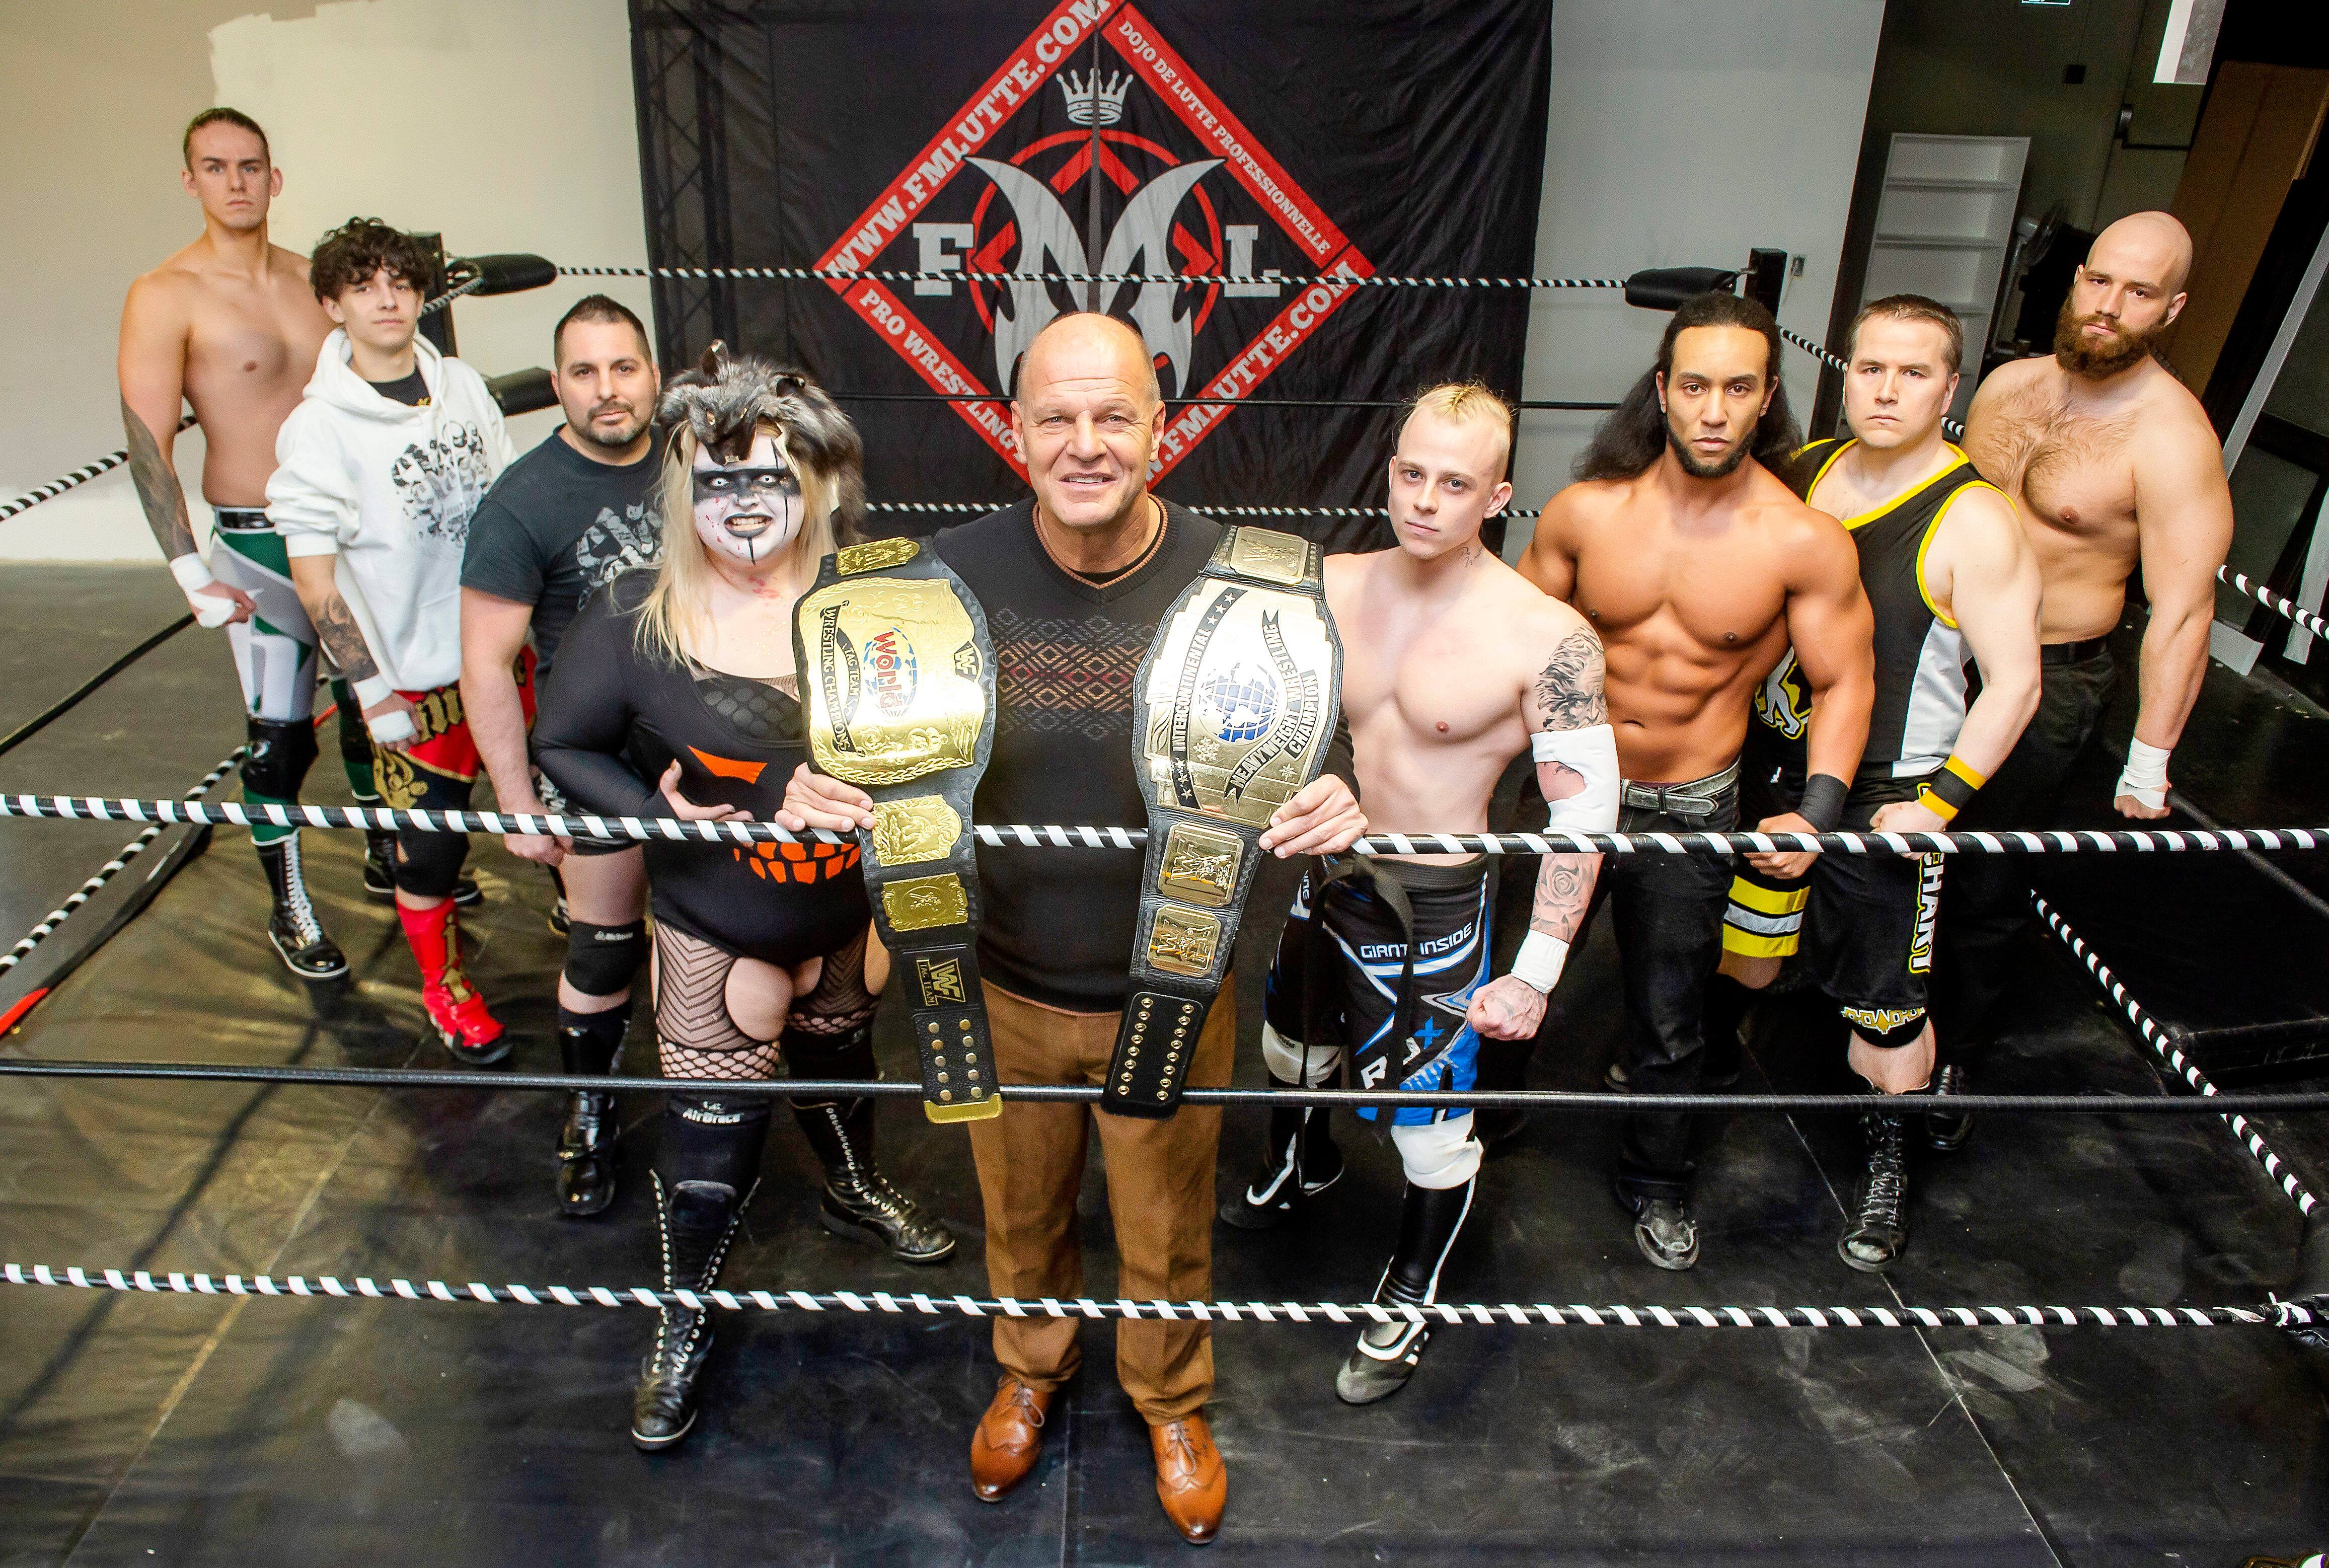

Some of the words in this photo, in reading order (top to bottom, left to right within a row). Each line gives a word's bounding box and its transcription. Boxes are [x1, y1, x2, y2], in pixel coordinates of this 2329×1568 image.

[824, 0, 1110, 277] WWW.FMLUTTE.COM
[1118, 21, 1156, 61] DOJO
[1152, 58, 1177, 84] DE
[1171, 79, 1219, 129] LUTTE
[1212, 125, 1332, 254] PROFESSIONNELLE
[859, 288, 907, 335] PRO
[903, 332, 1015, 450] WRESTLING
[1145, 260, 1361, 482] W.FMLUTTE.COM
[822, 607, 837, 673] WRESTLING
[1172, 628, 1213, 752] INTERCONTINENTAL
[1263, 624, 1302, 702] WRESTLING
[1231, 708, 1298, 788] HEAVYWEIGHT
[1289, 674, 1319, 755] CHAMPION
[1361, 944, 1408, 958] GIANT
[1419, 922, 1472, 955] INSIDE
